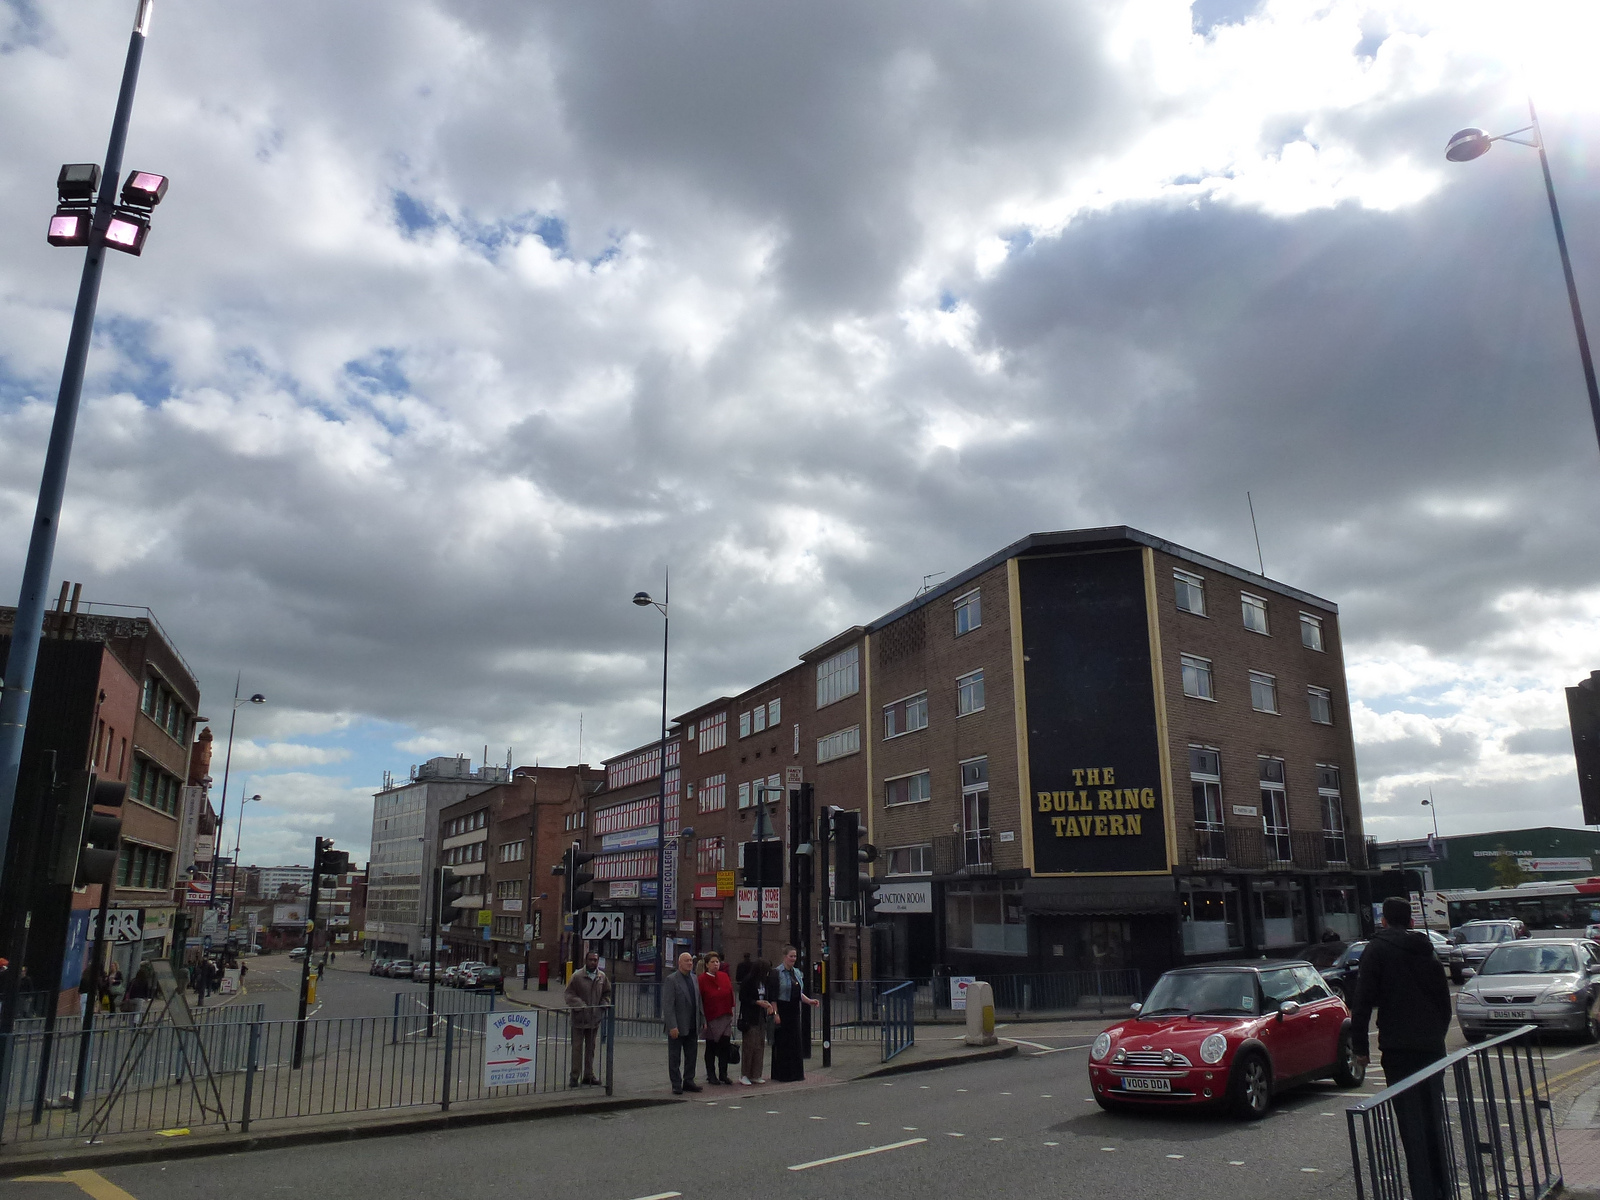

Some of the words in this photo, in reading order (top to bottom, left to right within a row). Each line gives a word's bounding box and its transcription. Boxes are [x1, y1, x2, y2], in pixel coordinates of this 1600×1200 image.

[1072, 767, 1115, 786] THE
[1037, 790, 1093, 812] BULL
[1097, 787, 1155, 810] RING
[1051, 814, 1142, 837] TAVERN
[664, 850, 672, 882] COLLEGE
[664, 883, 672, 909] EMPIRE
[739, 890, 752, 901] FANCY
[765, 889, 778, 901] STORE
[879, 893, 906, 903] FUNCTION
[907, 892, 925, 903] ROOM
[494, 1017, 506, 1028] THE
[508, 1015, 531, 1027] GLOVES
[1151, 1080, 1169, 1089] DDA
